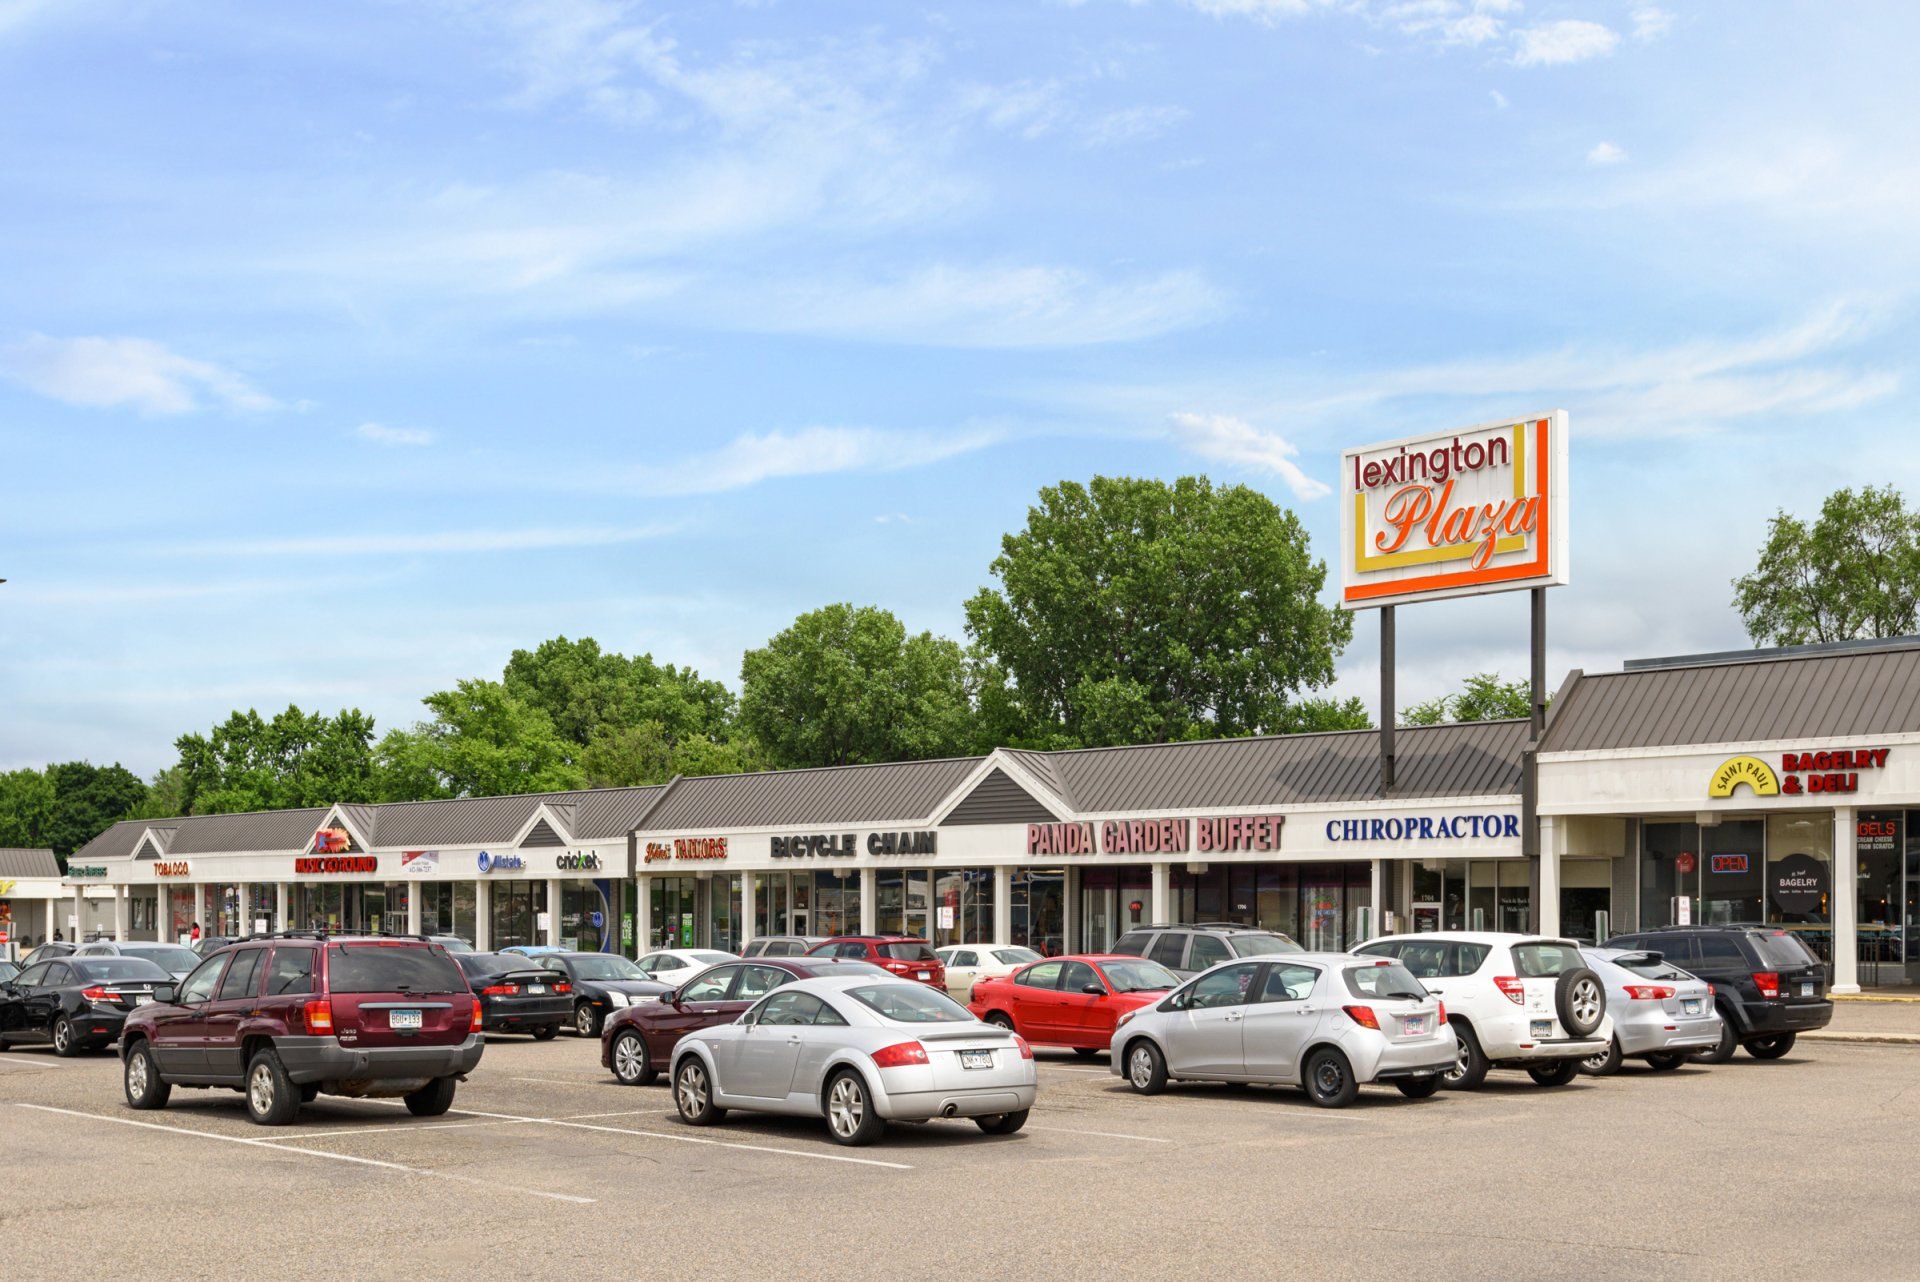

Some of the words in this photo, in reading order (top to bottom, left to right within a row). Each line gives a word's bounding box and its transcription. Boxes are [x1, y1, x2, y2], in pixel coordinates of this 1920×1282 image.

[1355, 436, 1508, 490] lexington
[1375, 479, 1541, 570] Plaza
[1782, 749, 1890, 772] BAGELRY
[1717, 762, 1743, 790] SAINT
[1746, 762, 1769, 789] PAUL
[1782, 774, 1803, 795] &
[1808, 772, 1858, 793] DELI
[1028, 822, 1097, 854] PANDA
[1101, 819, 1190, 854] GARDEN
[1197, 815, 1285, 851] BUFFET
[1326, 814, 1520, 841] CHIROPRACTOR
[674, 837, 728, 859] TAILORS
[771, 833, 857, 857] BICYCLE
[867, 831, 937, 855] CHAIN
[154, 861, 189, 876] TOBACCO
[295, 857, 324, 873] MUSIC
[324, 857, 340, 873] GO
[340, 856, 377, 873] ROUND
[493, 855, 521, 868] Allstate
[556, 850, 598, 870] cricket
[1714, 856, 1747, 871] OPEN
[1779, 878, 1818, 886] BAGELRY
[622, 919, 632, 929] 4G
[622, 929, 632, 940] LTE
